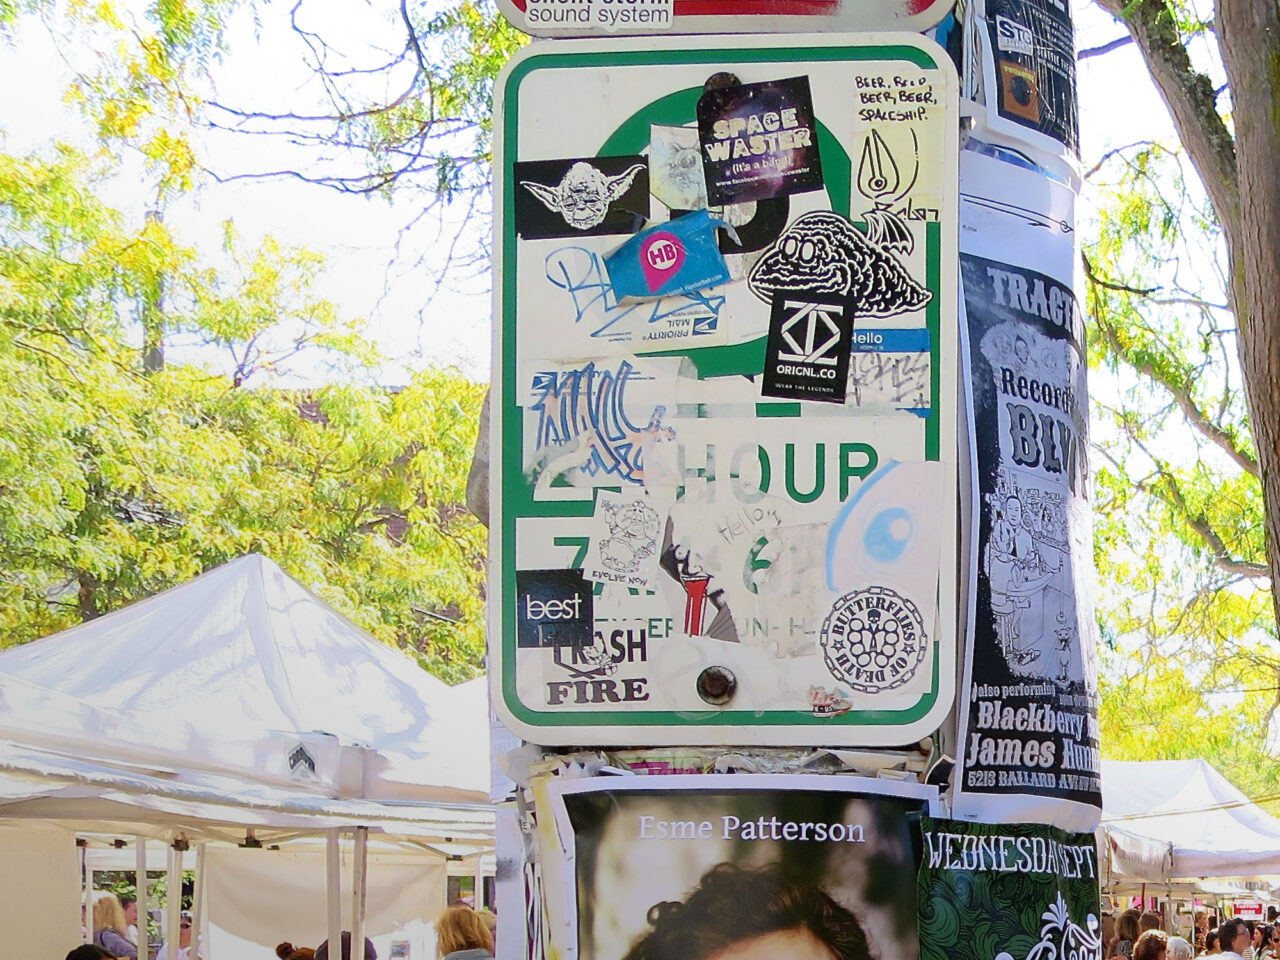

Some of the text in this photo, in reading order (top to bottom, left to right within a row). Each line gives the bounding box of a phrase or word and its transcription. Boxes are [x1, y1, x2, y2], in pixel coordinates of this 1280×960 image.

[528, 5, 669, 27] sound system
[713, 107, 798, 140] SPACE
[705, 127, 812, 162] WASTER
[649, 244, 676, 265] HB
[676, 442, 879, 504] HOUR
[526, 593, 582, 620] best
[832, 596, 916, 642] BUTTERFLIES
[835, 652, 886, 684] DEATH
[890, 656, 908, 678] OF
[546, 678, 650, 705] FIRE
[978, 684, 1000, 698] also
[977, 700, 1085, 742] Blackberry
[965, 733, 1056, 769] James
[998, 771, 1056, 789] BALLARD
[638, 815, 866, 844] Esme Patterson
